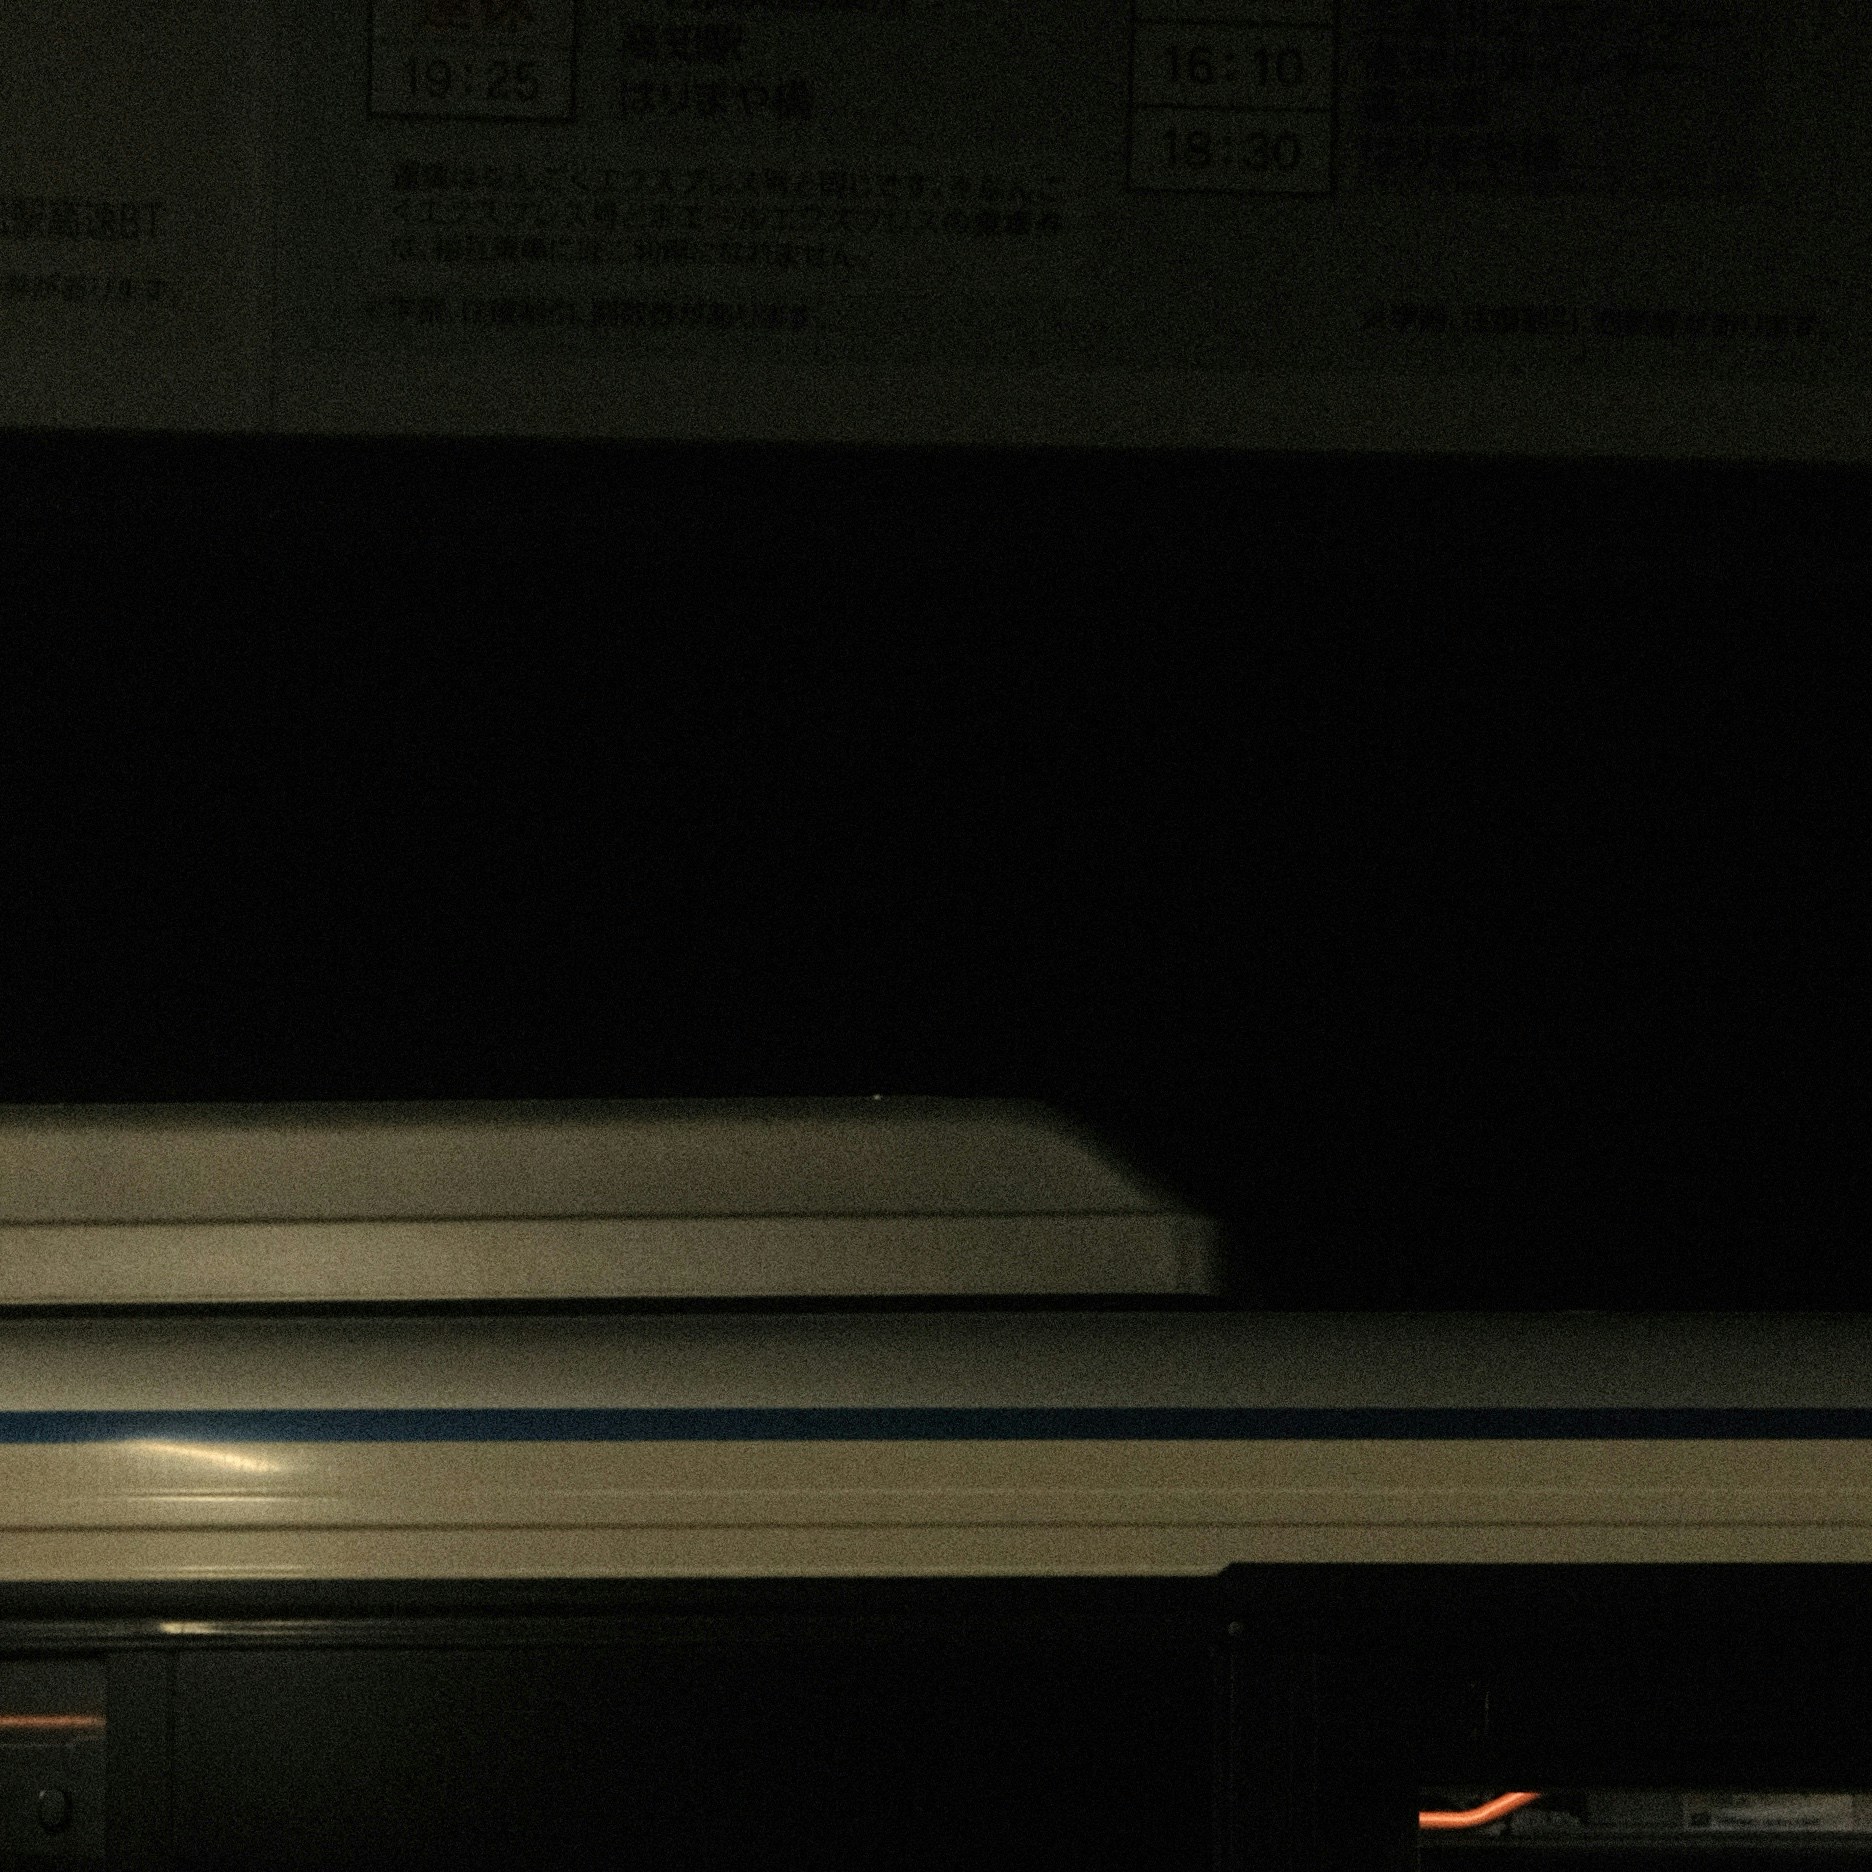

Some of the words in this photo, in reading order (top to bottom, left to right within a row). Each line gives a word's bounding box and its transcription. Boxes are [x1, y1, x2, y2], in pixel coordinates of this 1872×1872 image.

[406, 57, 540, 101] 19:25
[1164, 45, 1304, 86] 16:10
[1162, 128, 1301, 171] 18:30
